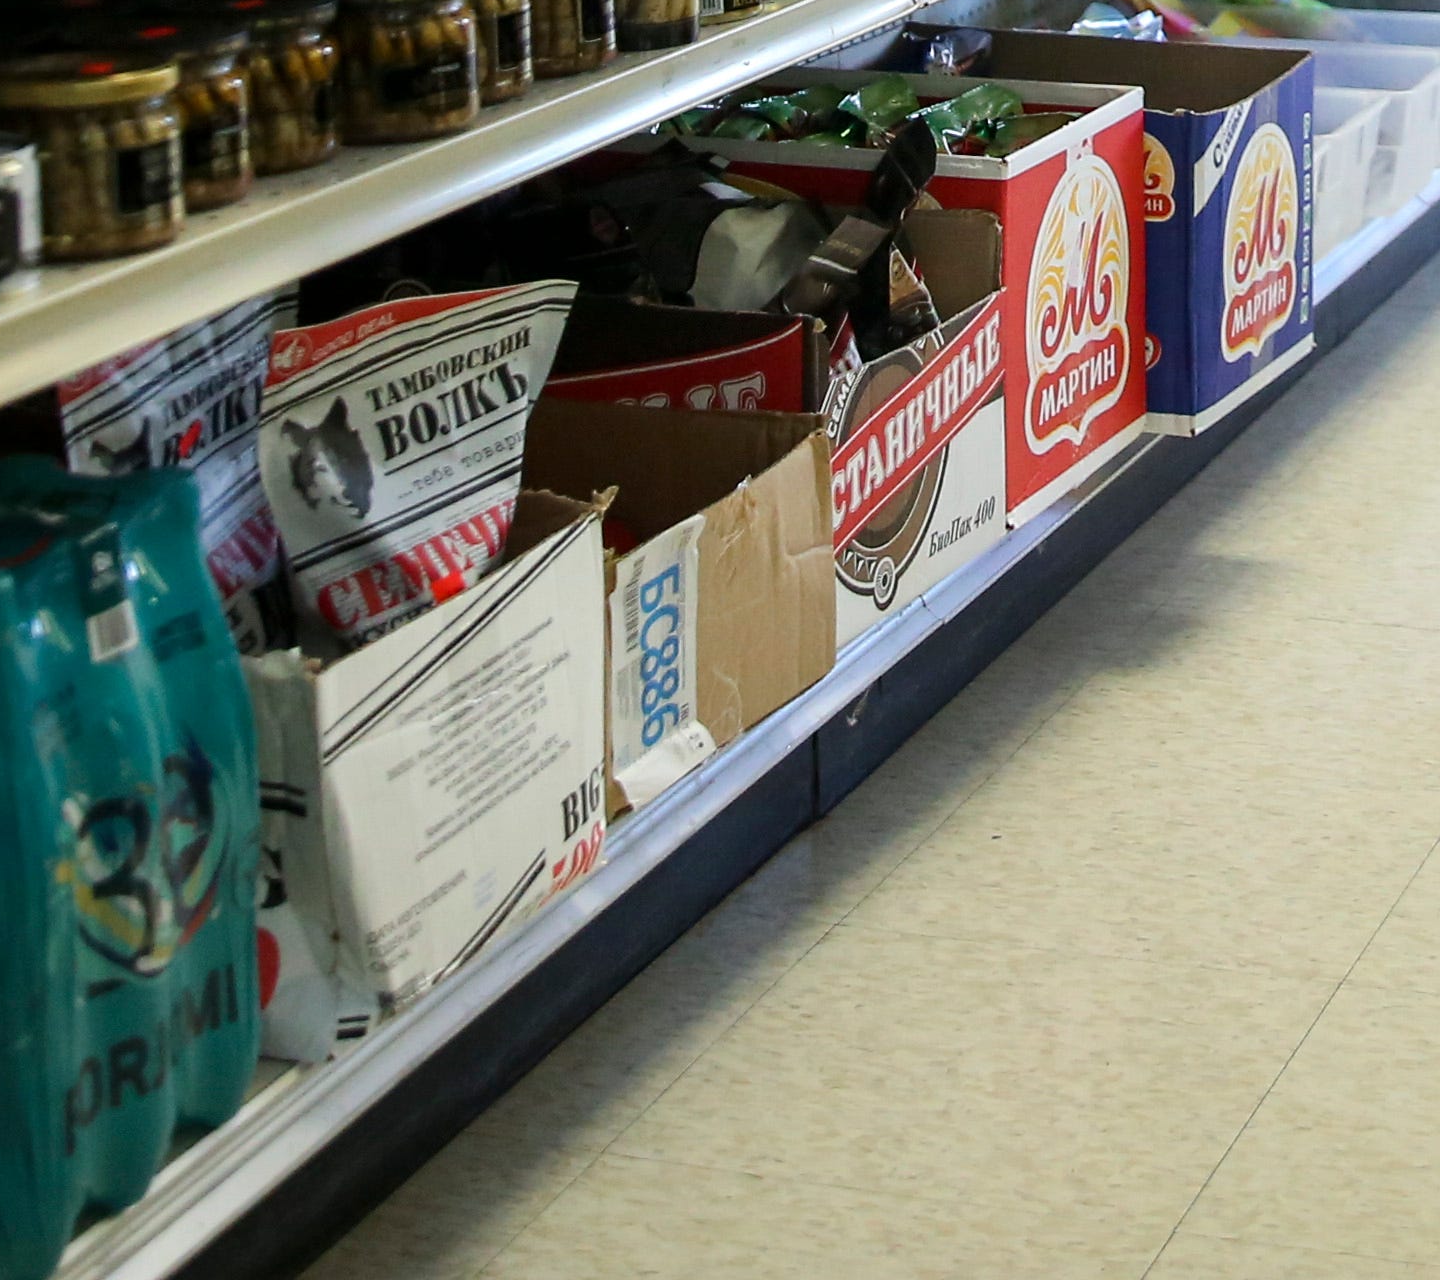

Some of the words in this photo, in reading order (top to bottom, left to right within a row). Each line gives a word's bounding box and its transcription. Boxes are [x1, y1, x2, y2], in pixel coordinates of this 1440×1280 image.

[311, 328, 356, 361] GOOD
[357, 312, 395, 340] DEAL
[1231, 276, 1286, 337] МАРТИН
[365, 324, 532, 412] ТАМБОВСКИЙ
[826, 370, 859, 440] СЕМЕ
[1038, 344, 1117, 426] МАРТИН
[374, 360, 529, 462] ВОЛКЪ
[831, 313, 1003, 528] СТАНИЧНЫЕ
[927, 514, 973, 559] БиоПак
[973, 494, 997, 532] 400
